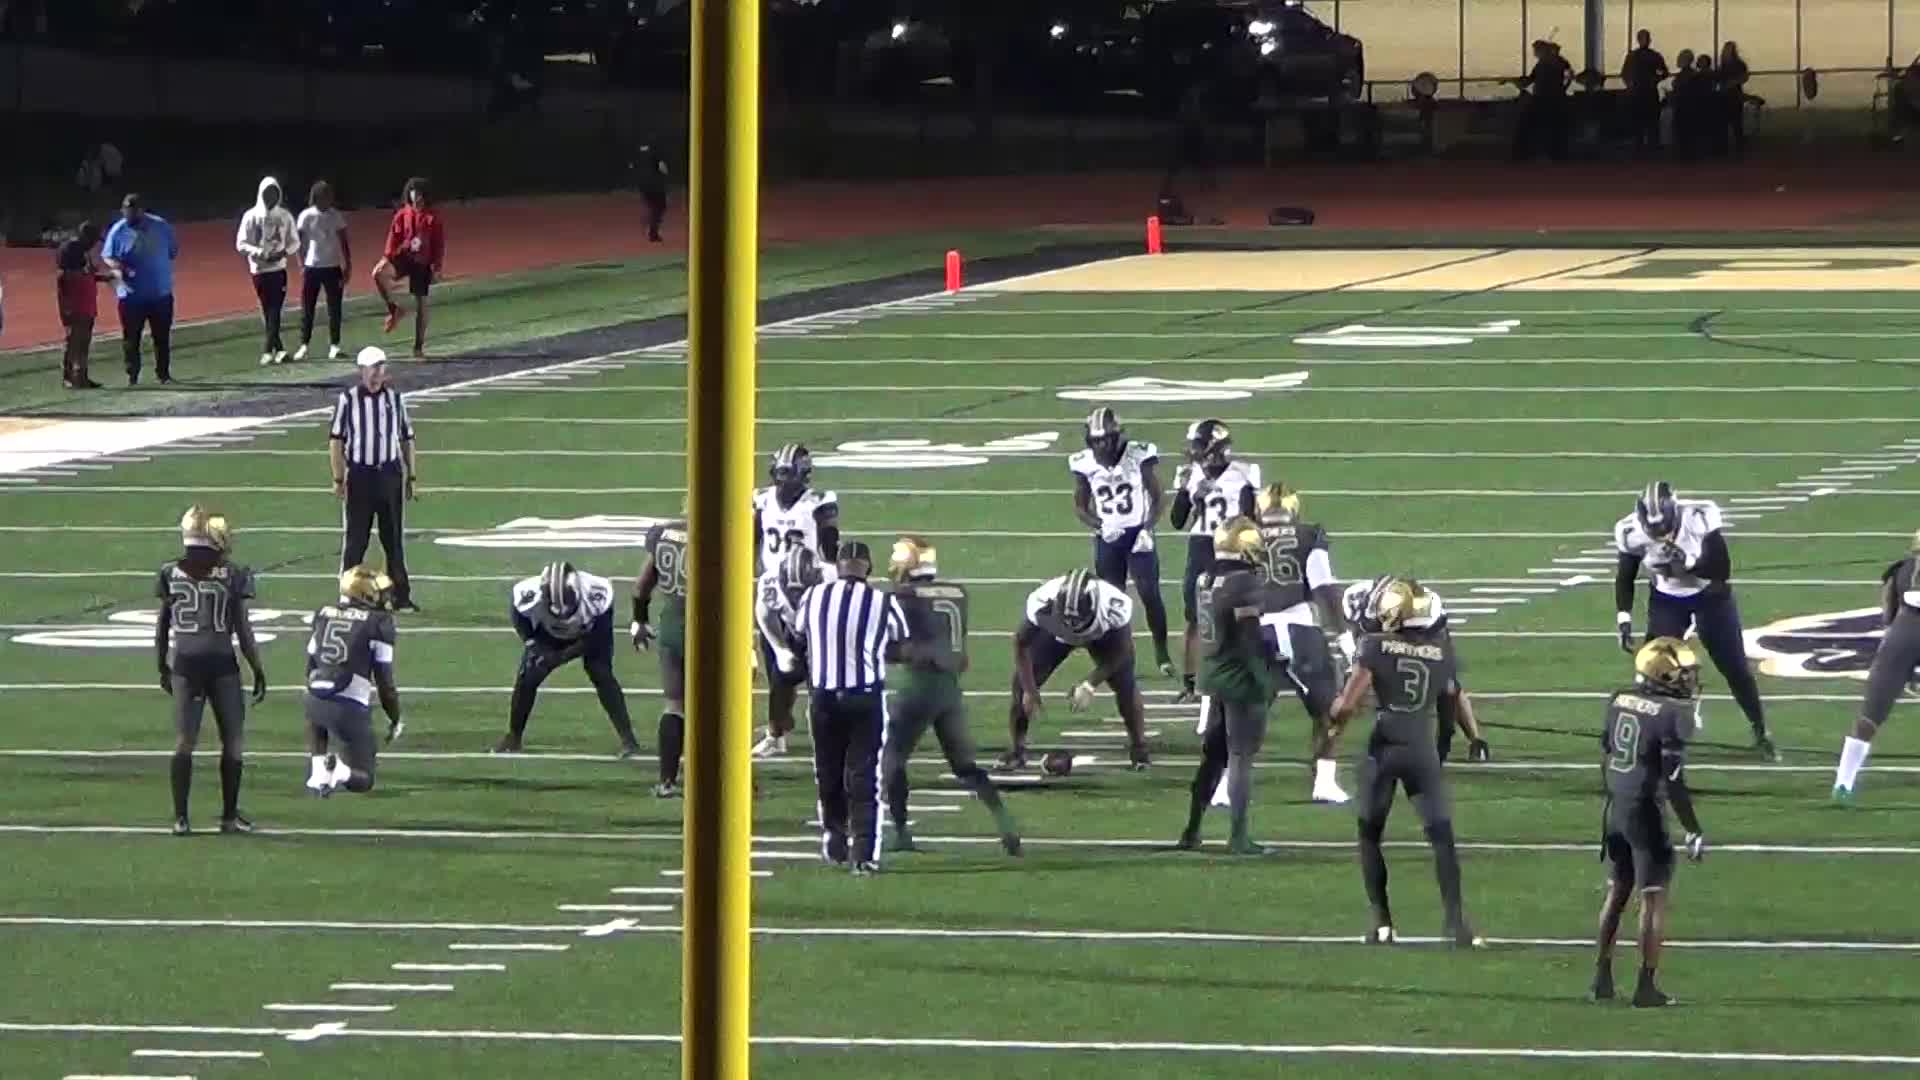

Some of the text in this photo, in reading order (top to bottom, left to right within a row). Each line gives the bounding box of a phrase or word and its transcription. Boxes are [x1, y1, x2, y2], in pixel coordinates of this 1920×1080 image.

[1097, 483, 1133, 515] 23
[655, 543, 688, 596] 9
[169, 581, 228, 632] 27
[320, 619, 353, 664] 5
[1388, 657, 1430, 713] 3
[1609, 712, 1641, 773] 9
